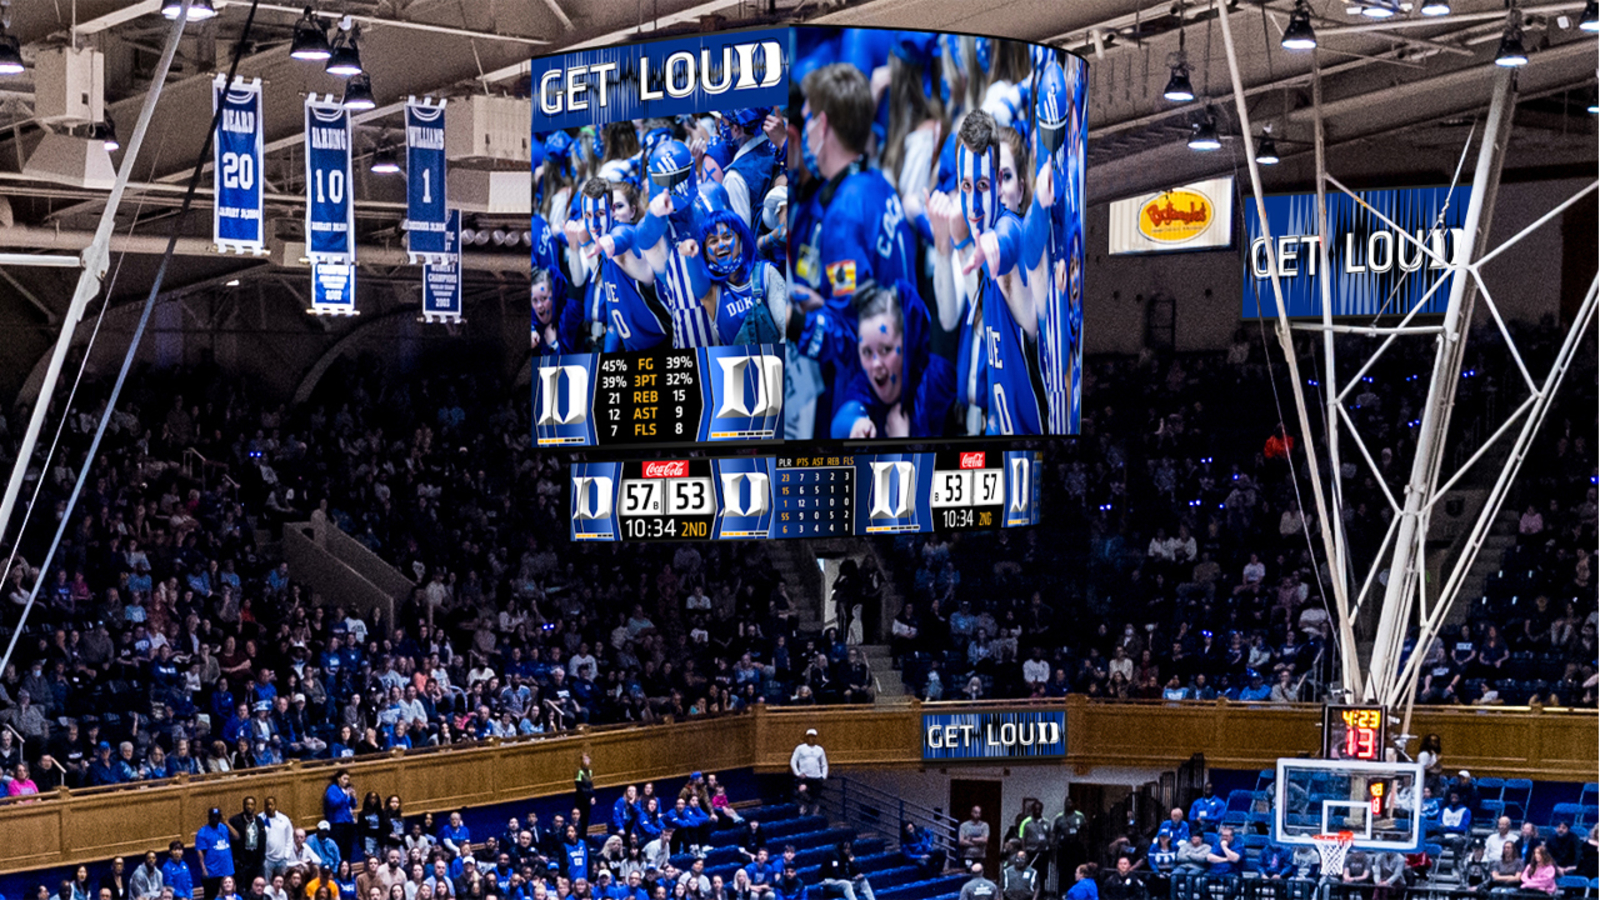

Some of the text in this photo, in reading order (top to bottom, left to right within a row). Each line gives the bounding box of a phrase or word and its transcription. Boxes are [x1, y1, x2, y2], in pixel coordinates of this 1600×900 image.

[540, 38, 782, 115] GET LOUD
[222, 108, 254, 133] BEARD
[408, 126, 444, 150] WILLIAMS
[222, 152, 254, 190] 20
[315, 168, 344, 204] 10
[422, 168, 432, 203] 1
[725, 295, 754, 317] DUK
[601, 355, 693, 372] 45% FG 39%
[602, 372, 693, 389] 39% 3PT 32%
[608, 389, 686, 405] 21 REB 15
[608, 405, 684, 421] 12 AST 9
[610, 422, 683, 437] 7 FLS 8
[778, 456, 854, 467] PLR PTS AST REB FLS
[781, 471, 850, 482] 23 7 3 2 3
[626, 483, 654, 511] 57
[676, 481, 706, 510] 53
[782, 484, 849, 495] 15 6 5 1 1
[945, 473, 963, 502] 53
[983, 473, 997, 501] 57
[783, 497, 850, 508] 1 12 1 0 0
[781, 512, 790, 521] 55
[814, 511, 820, 520] 0
[829, 510, 835, 520] 5
[844, 509, 849, 519] 2
[942, 508, 974, 528] 10:34
[625, 518, 707, 538] 10:34 2ND
[782, 523, 849, 534] 6 3 4 4 1
[1342, 710, 1381, 729] 4:23
[928, 722, 1059, 748] GET LOUD
[1346, 728, 1374, 758] 13
